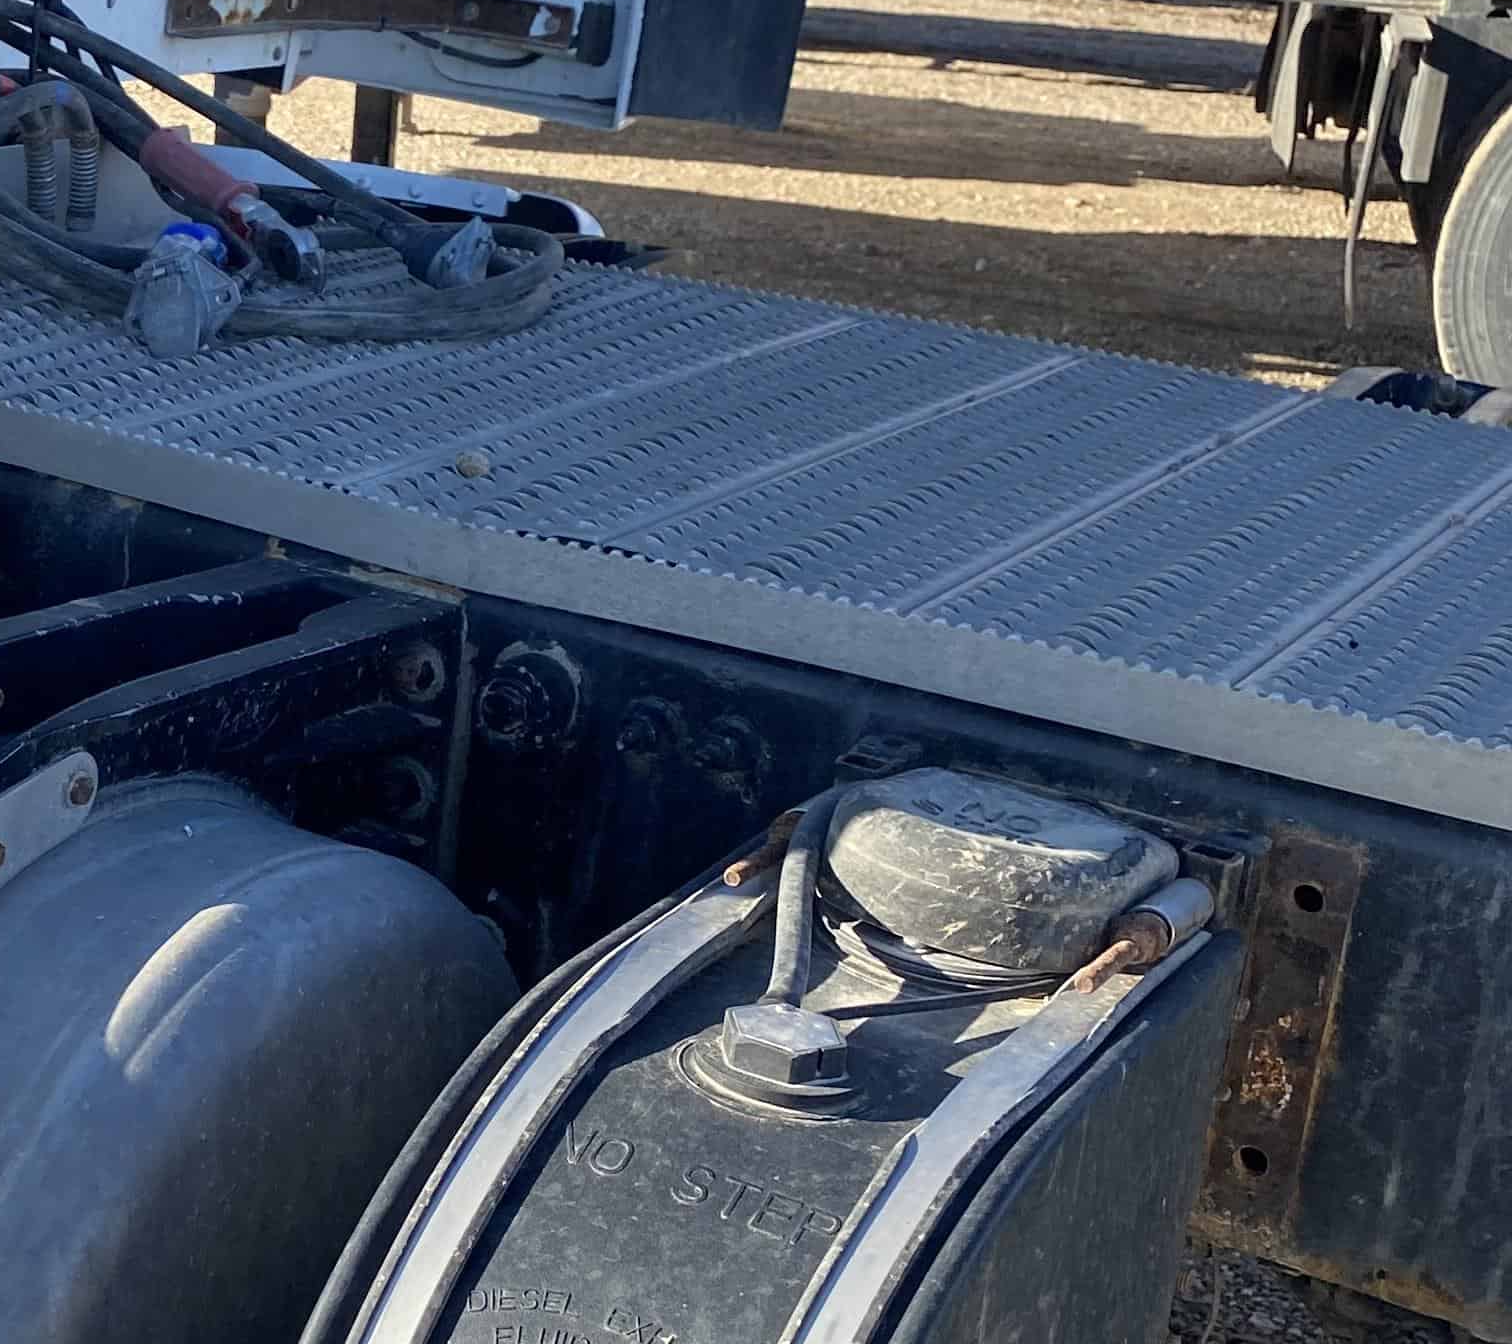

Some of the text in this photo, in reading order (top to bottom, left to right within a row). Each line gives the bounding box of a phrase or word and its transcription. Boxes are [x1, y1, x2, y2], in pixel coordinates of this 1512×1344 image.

[566, 1120, 842, 1248] NO STEP
[466, 1287, 581, 1319] DIESEL
